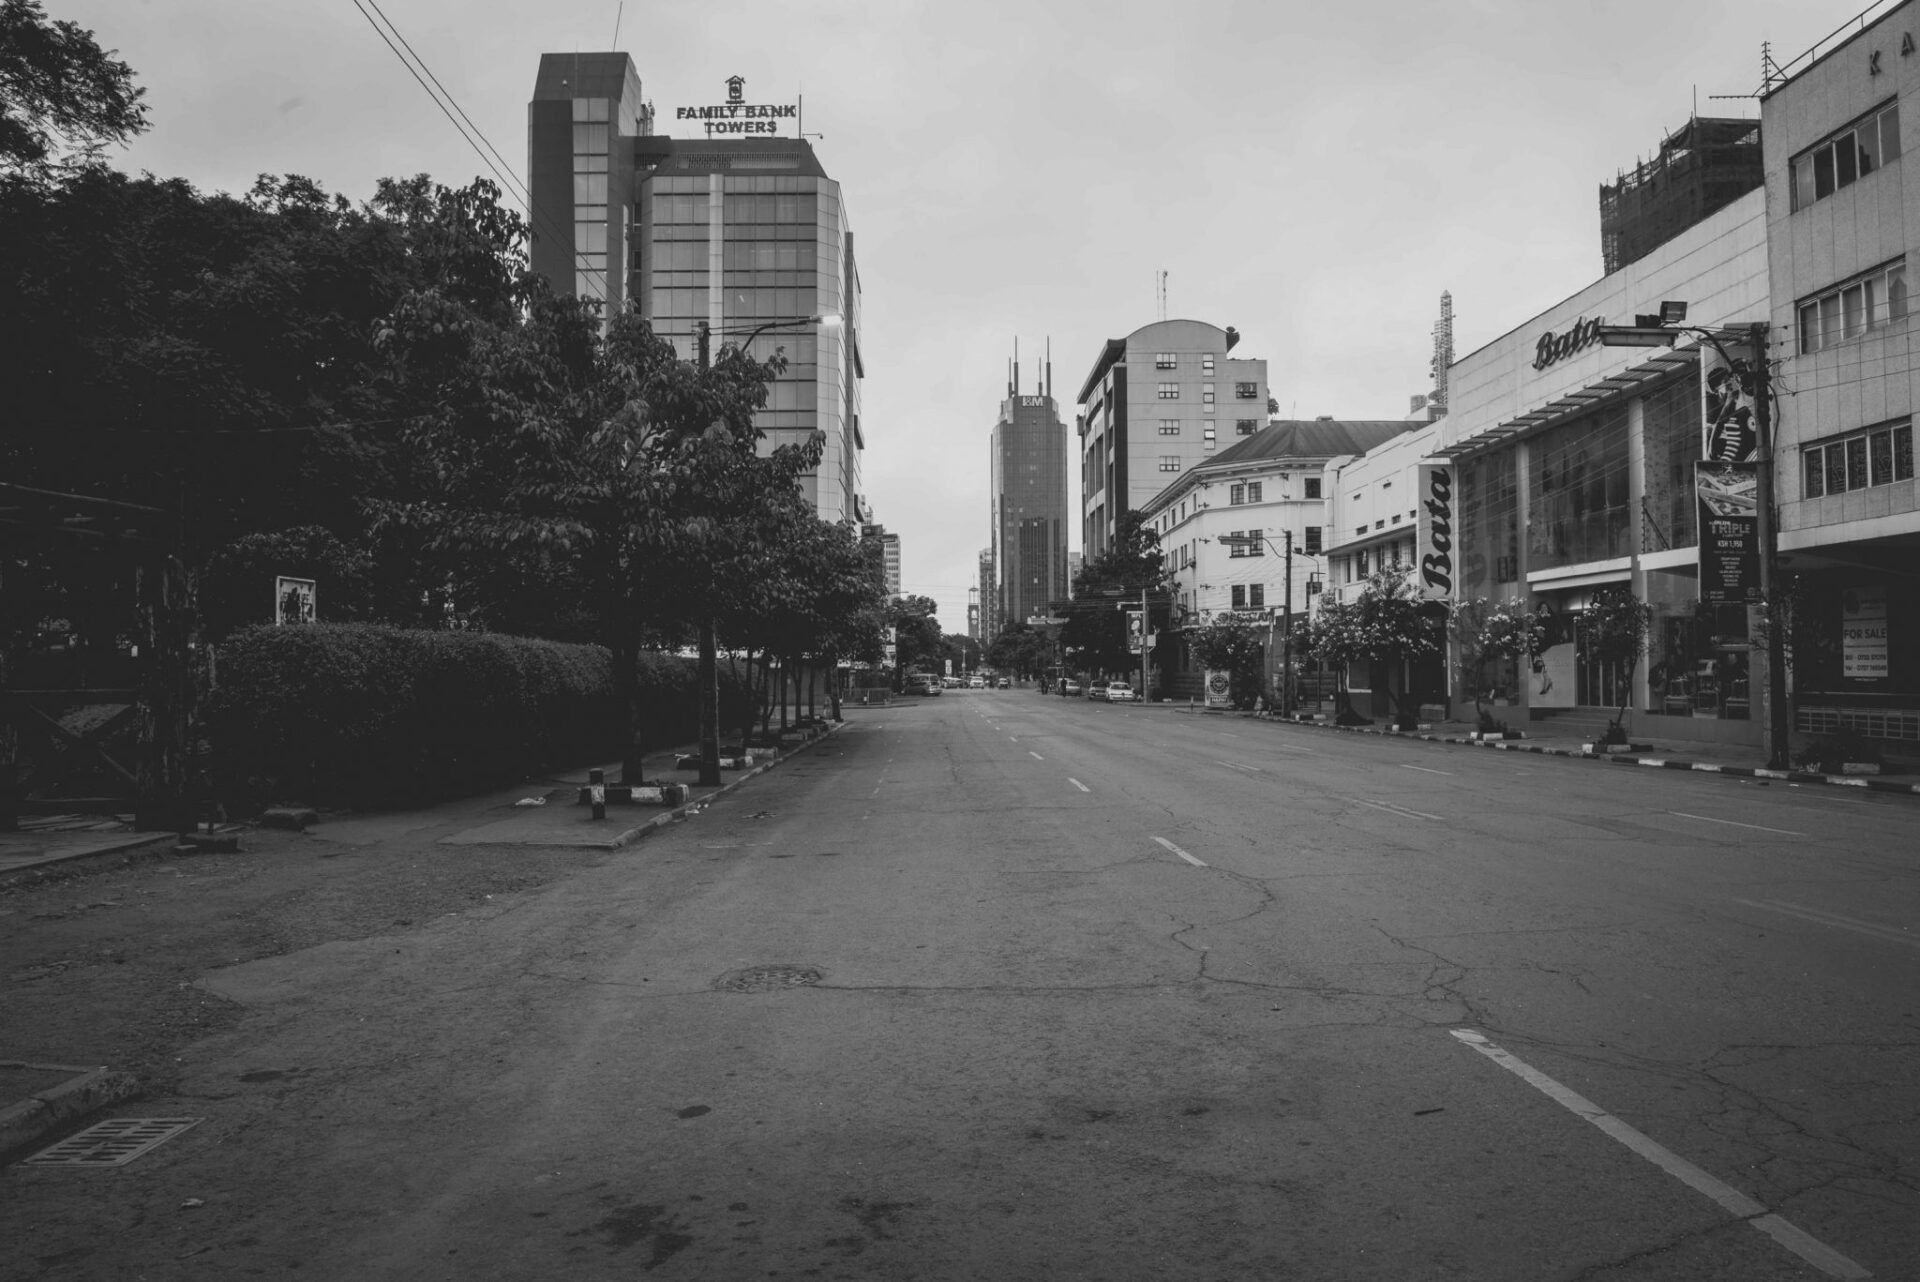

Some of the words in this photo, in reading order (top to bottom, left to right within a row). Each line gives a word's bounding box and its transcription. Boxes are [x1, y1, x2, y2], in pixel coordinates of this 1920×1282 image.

[677, 106, 738, 119] FAMILY
[745, 105, 797, 118] BANK
[704, 121, 777, 133] TOWERS
[1532, 316, 1605, 371] Bata
[1422, 467, 1452, 595] Bata
[1711, 523, 1751, 534] TRIPLE
[1844, 629, 1863, 640] FOR
[1864, 628, 1886, 639] SALE
